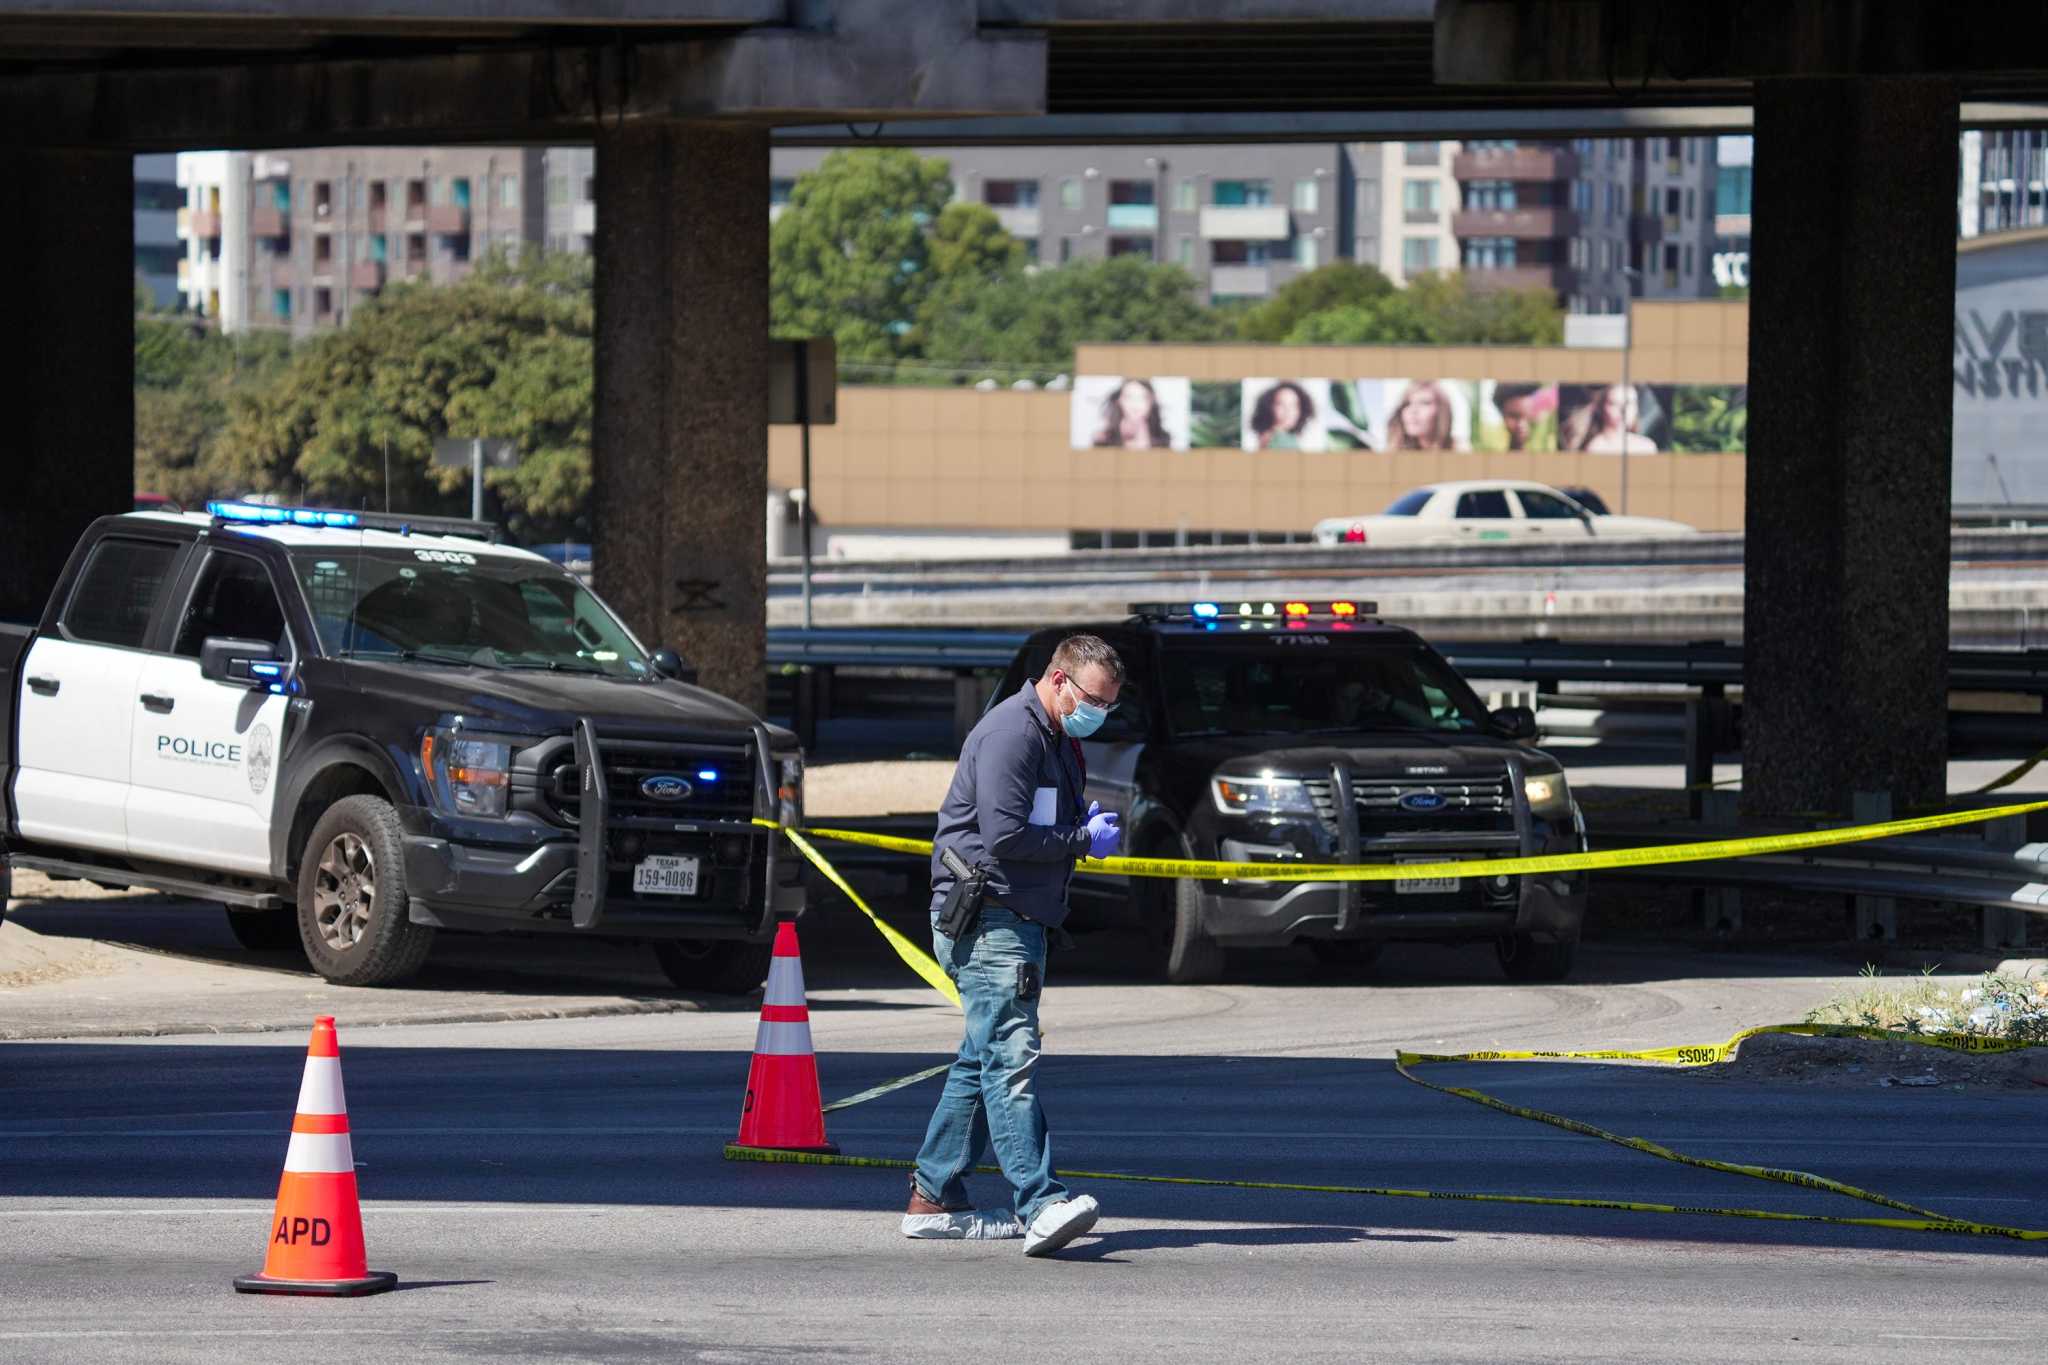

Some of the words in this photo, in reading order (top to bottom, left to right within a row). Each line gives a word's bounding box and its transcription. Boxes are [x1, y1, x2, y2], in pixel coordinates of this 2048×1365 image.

[156, 735, 241, 762] POLICE
[656, 858, 679, 866] TEXAS
[1678, 1048, 1715, 1063] CROSS
[275, 1217, 331, 1246] APD
